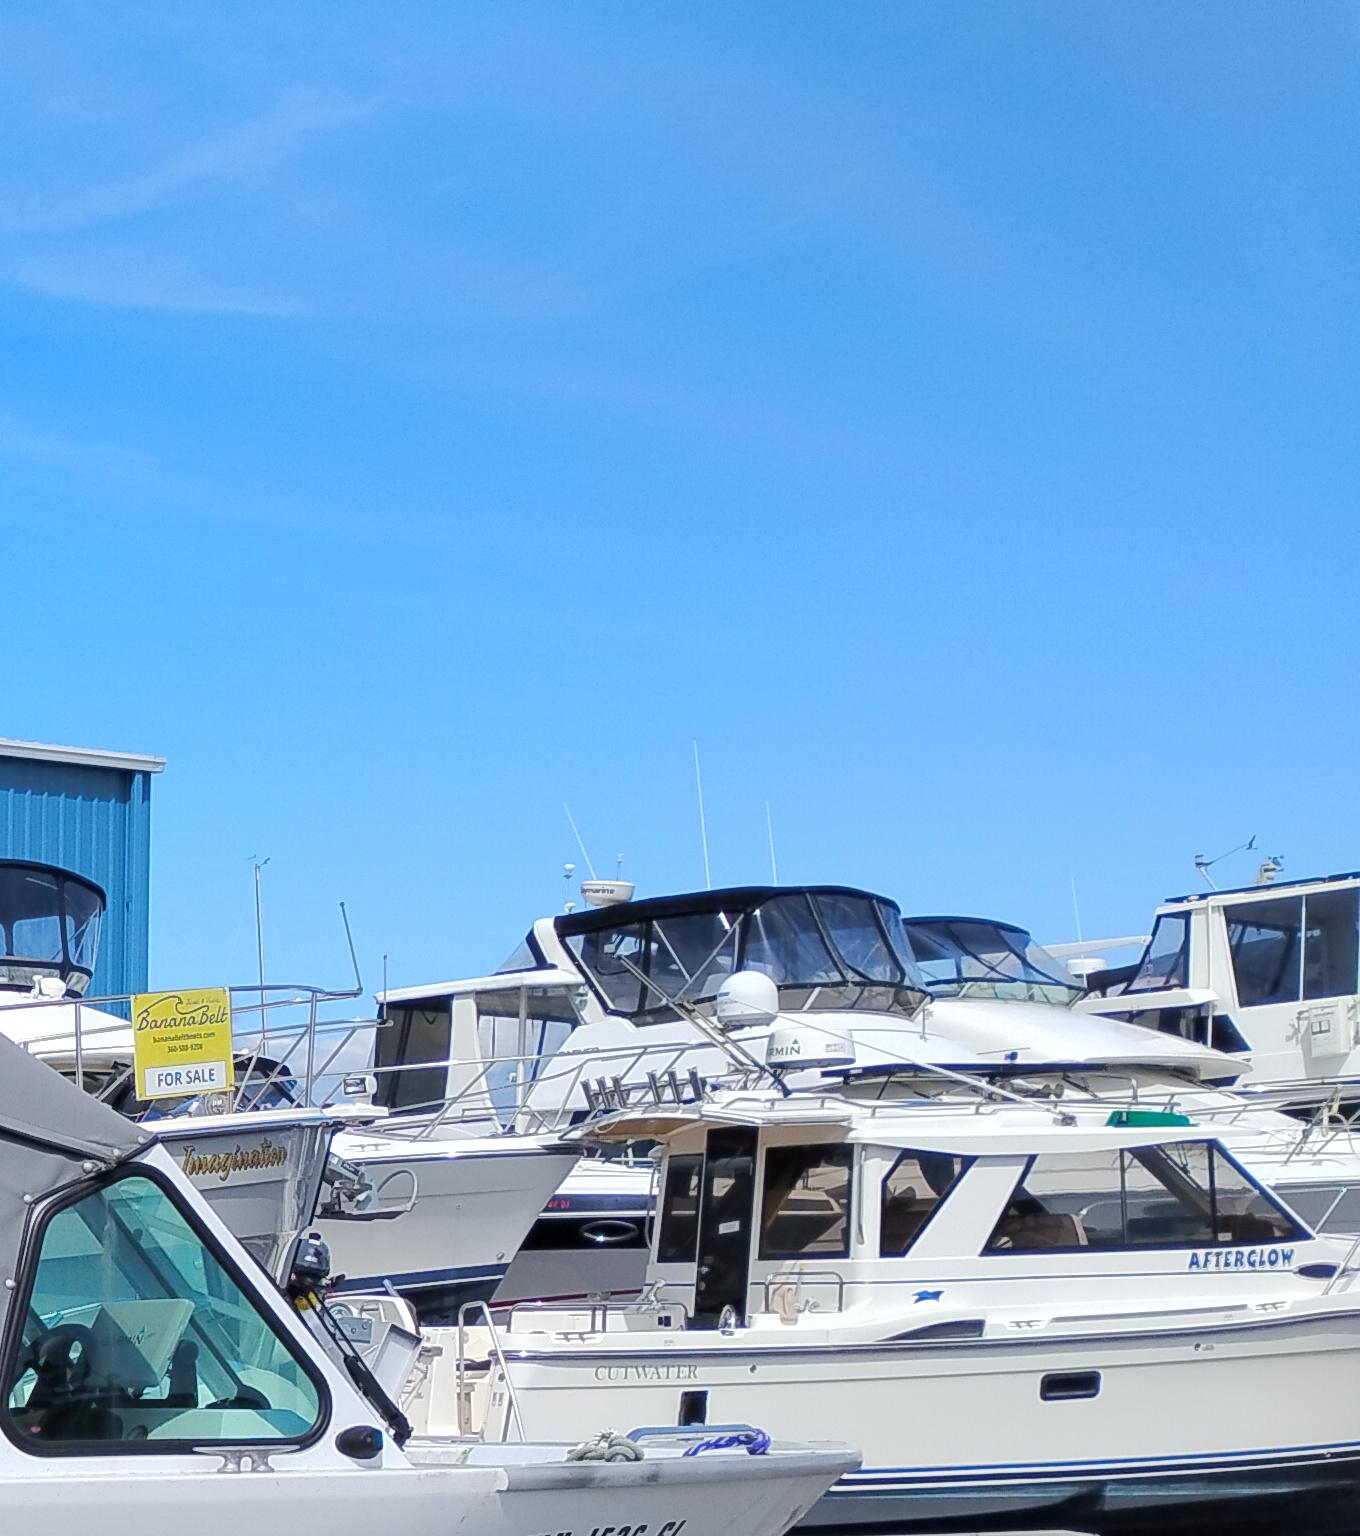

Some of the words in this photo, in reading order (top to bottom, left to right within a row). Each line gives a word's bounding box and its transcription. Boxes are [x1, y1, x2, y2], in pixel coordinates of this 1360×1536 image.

[157, 1071, 182, 1088] FOR
[185, 1068, 216, 1085] SALE
[182, 1137, 288, 1181] Imagination
[1188, 1248, 1295, 1270] AFTERGLOW
[594, 1364, 699, 1381] CUTWATER
